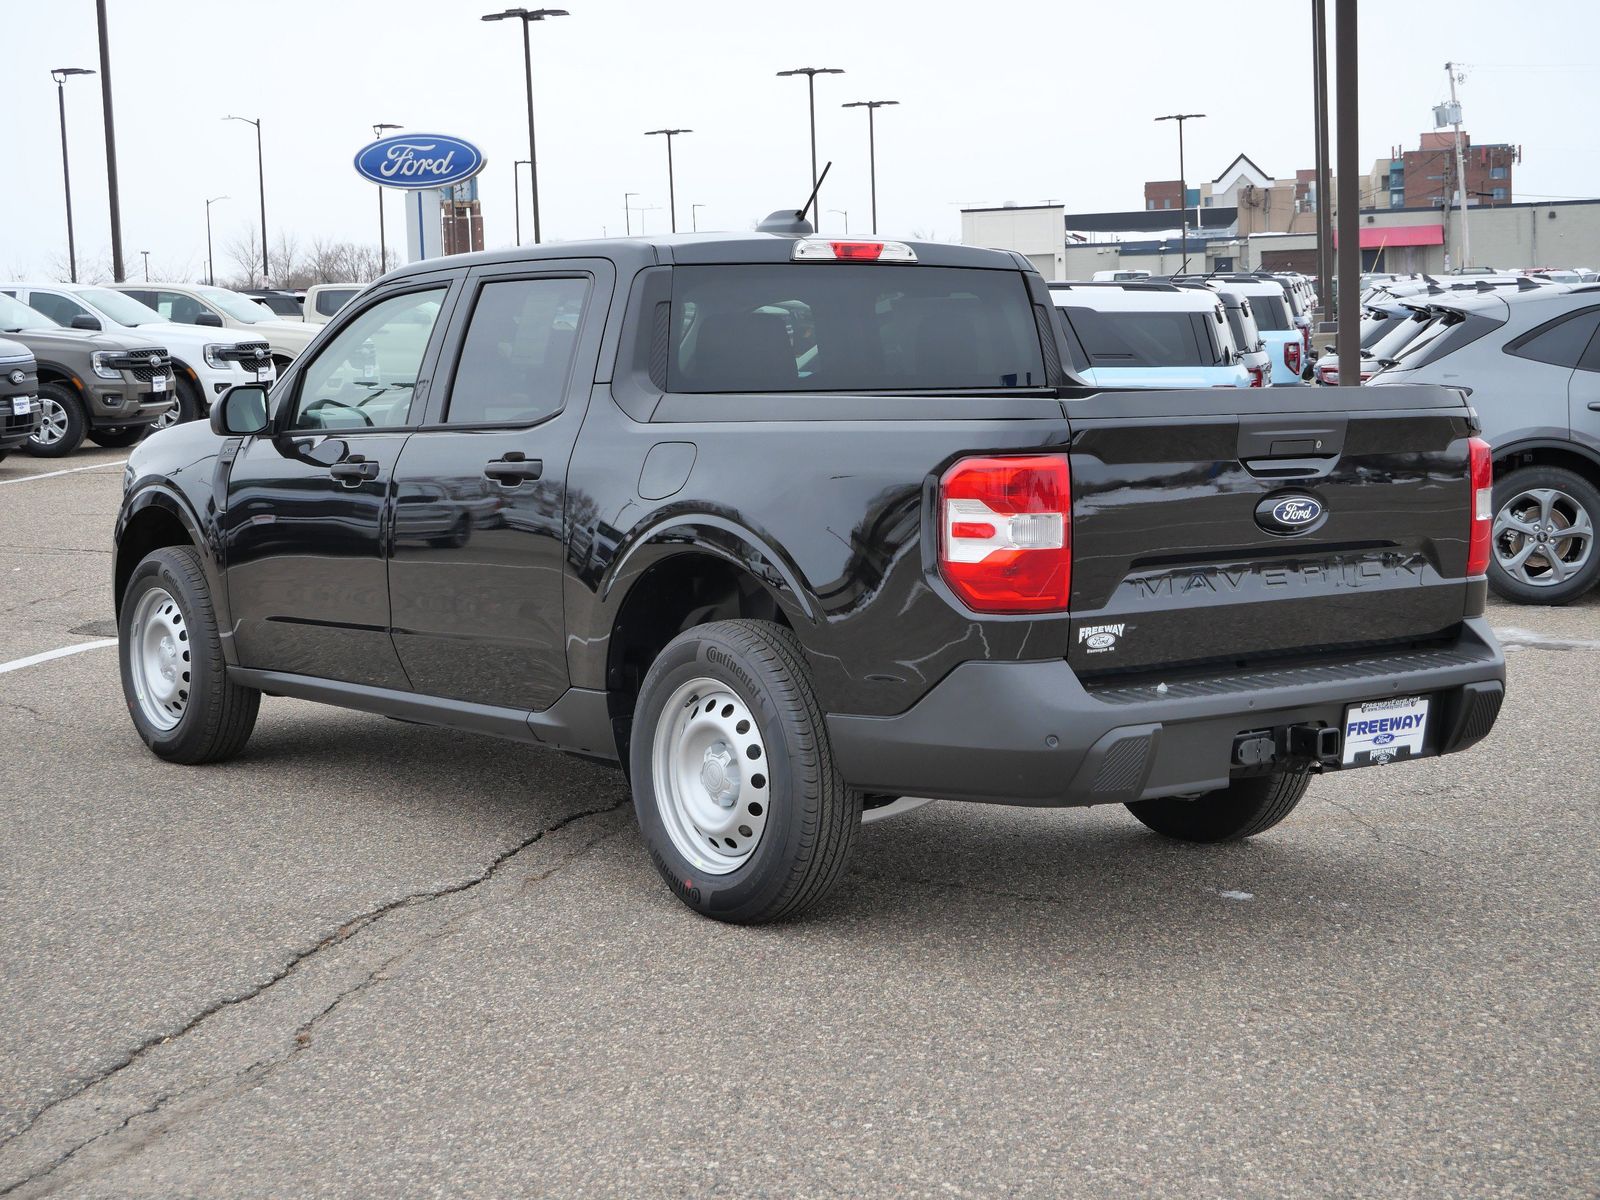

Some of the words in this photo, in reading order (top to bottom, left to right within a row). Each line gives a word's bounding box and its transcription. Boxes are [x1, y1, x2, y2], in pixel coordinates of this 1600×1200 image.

[380, 144, 455, 177] Ford
[1282, 502, 1312, 520] Ford
[1134, 551, 1422, 600] MAVERICK
[1078, 623, 1125, 644] FREEWAY
[706, 646, 760, 698] Continental
[1347, 714, 1424, 736] FREEWAY
